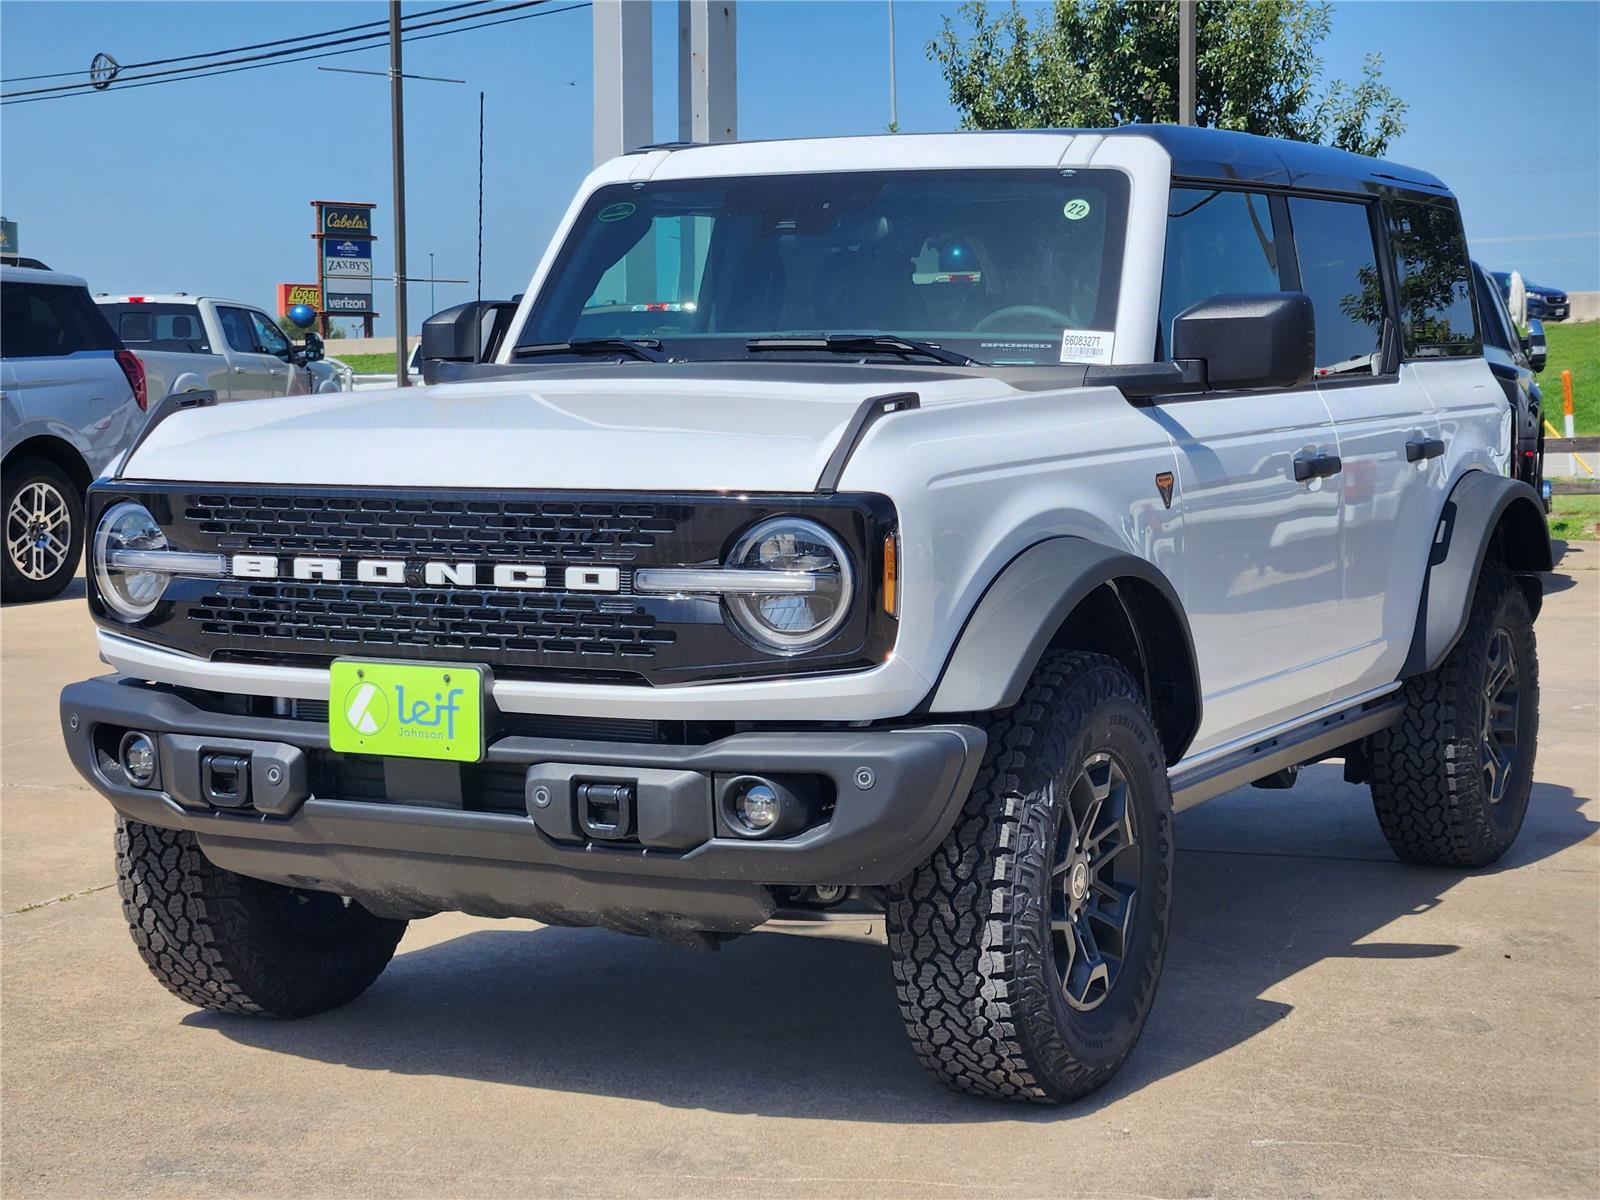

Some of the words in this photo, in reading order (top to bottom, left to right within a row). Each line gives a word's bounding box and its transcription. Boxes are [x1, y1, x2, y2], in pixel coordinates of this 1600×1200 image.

[1067, 203, 1086, 217] 22
[327, 212, 368, 229] Cabela's
[328, 260, 369, 272] ZAXBY'S
[328, 297, 366, 309] verizon
[1064, 335, 1101, 347] 6608327T
[232, 553, 620, 592] BRONCO
[395, 685, 464, 740] leif
[399, 728, 444, 740] Johnson
